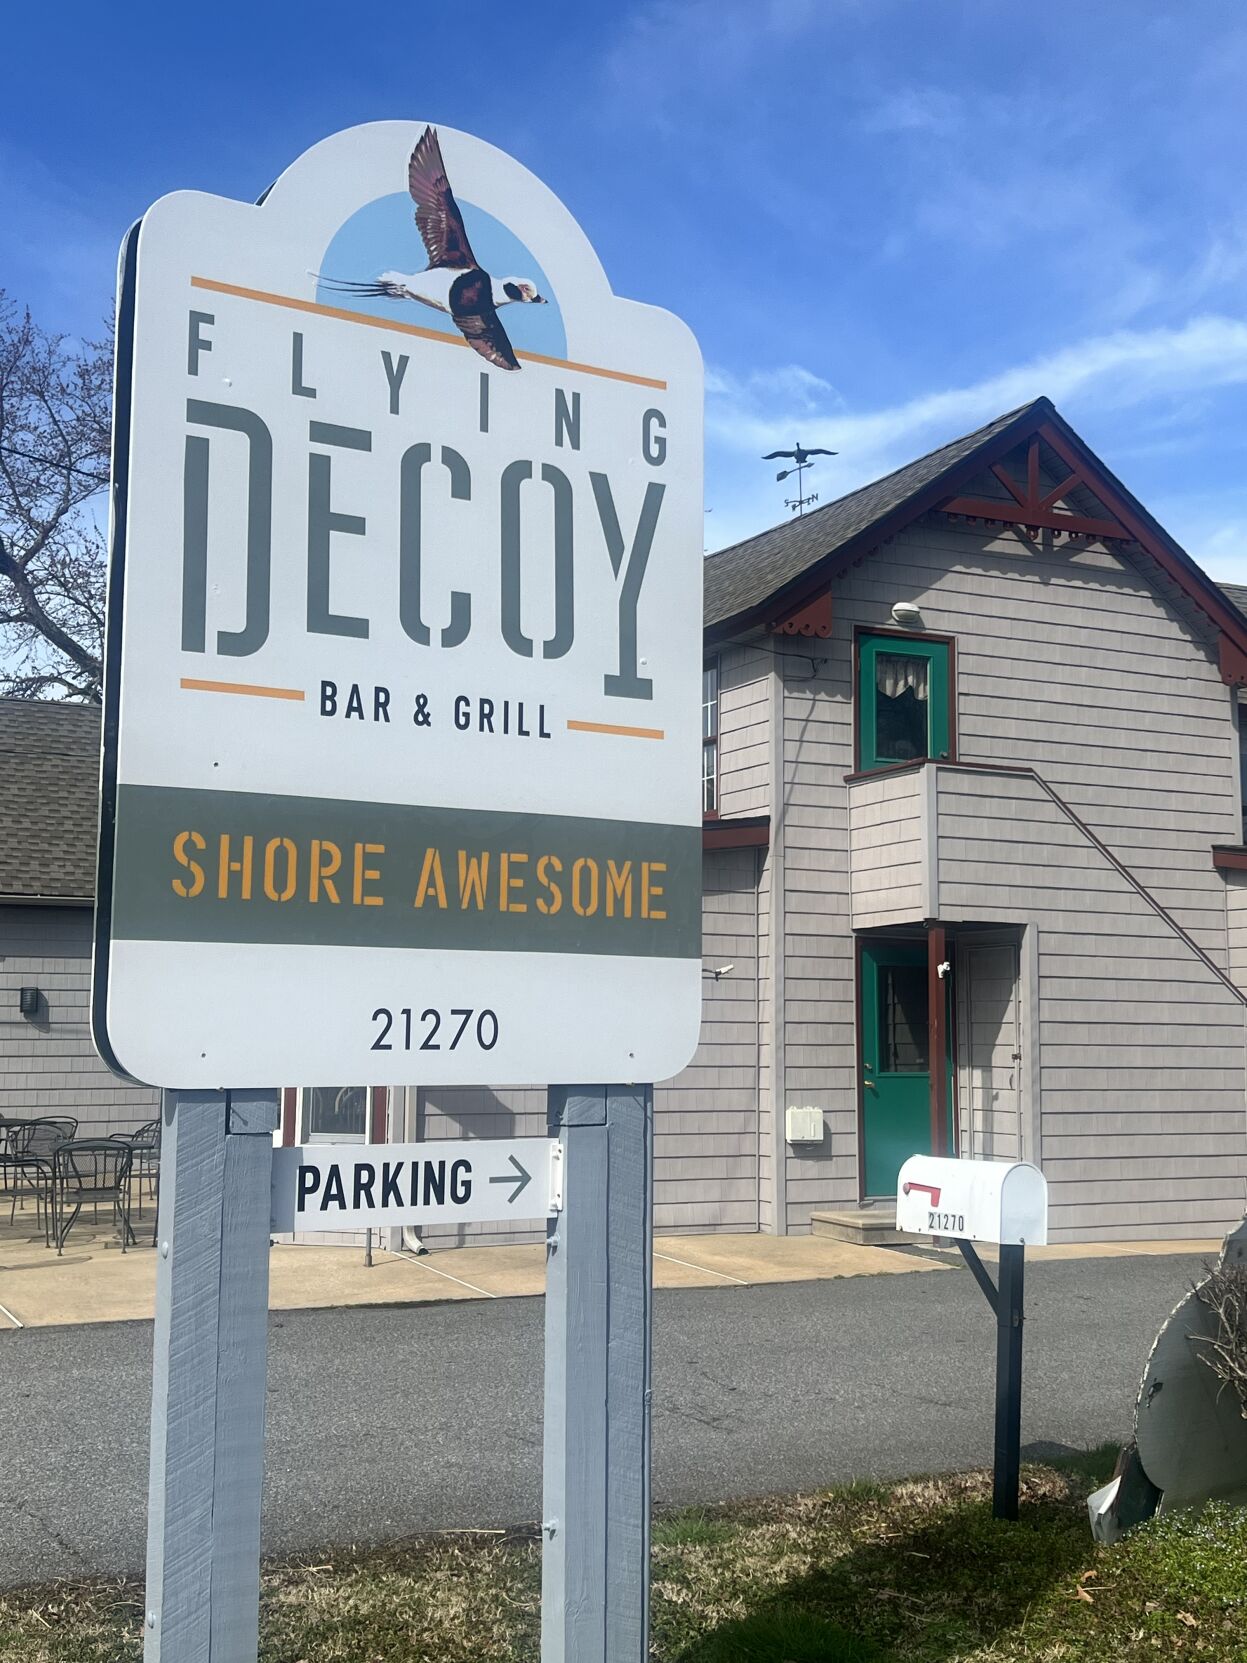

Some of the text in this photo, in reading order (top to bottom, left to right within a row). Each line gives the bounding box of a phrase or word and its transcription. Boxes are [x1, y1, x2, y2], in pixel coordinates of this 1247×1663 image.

[187, 309, 667, 467] FLYING
[181, 397, 667, 700] DECOY
[320, 680, 552, 739] BAR & GRILL
[171, 830, 668, 920] SHORE AWESOME
[370, 1007, 499, 1052] 21270
[297, 1158, 473, 1213] PARKING
[929, 1213, 964, 1231] 21270
